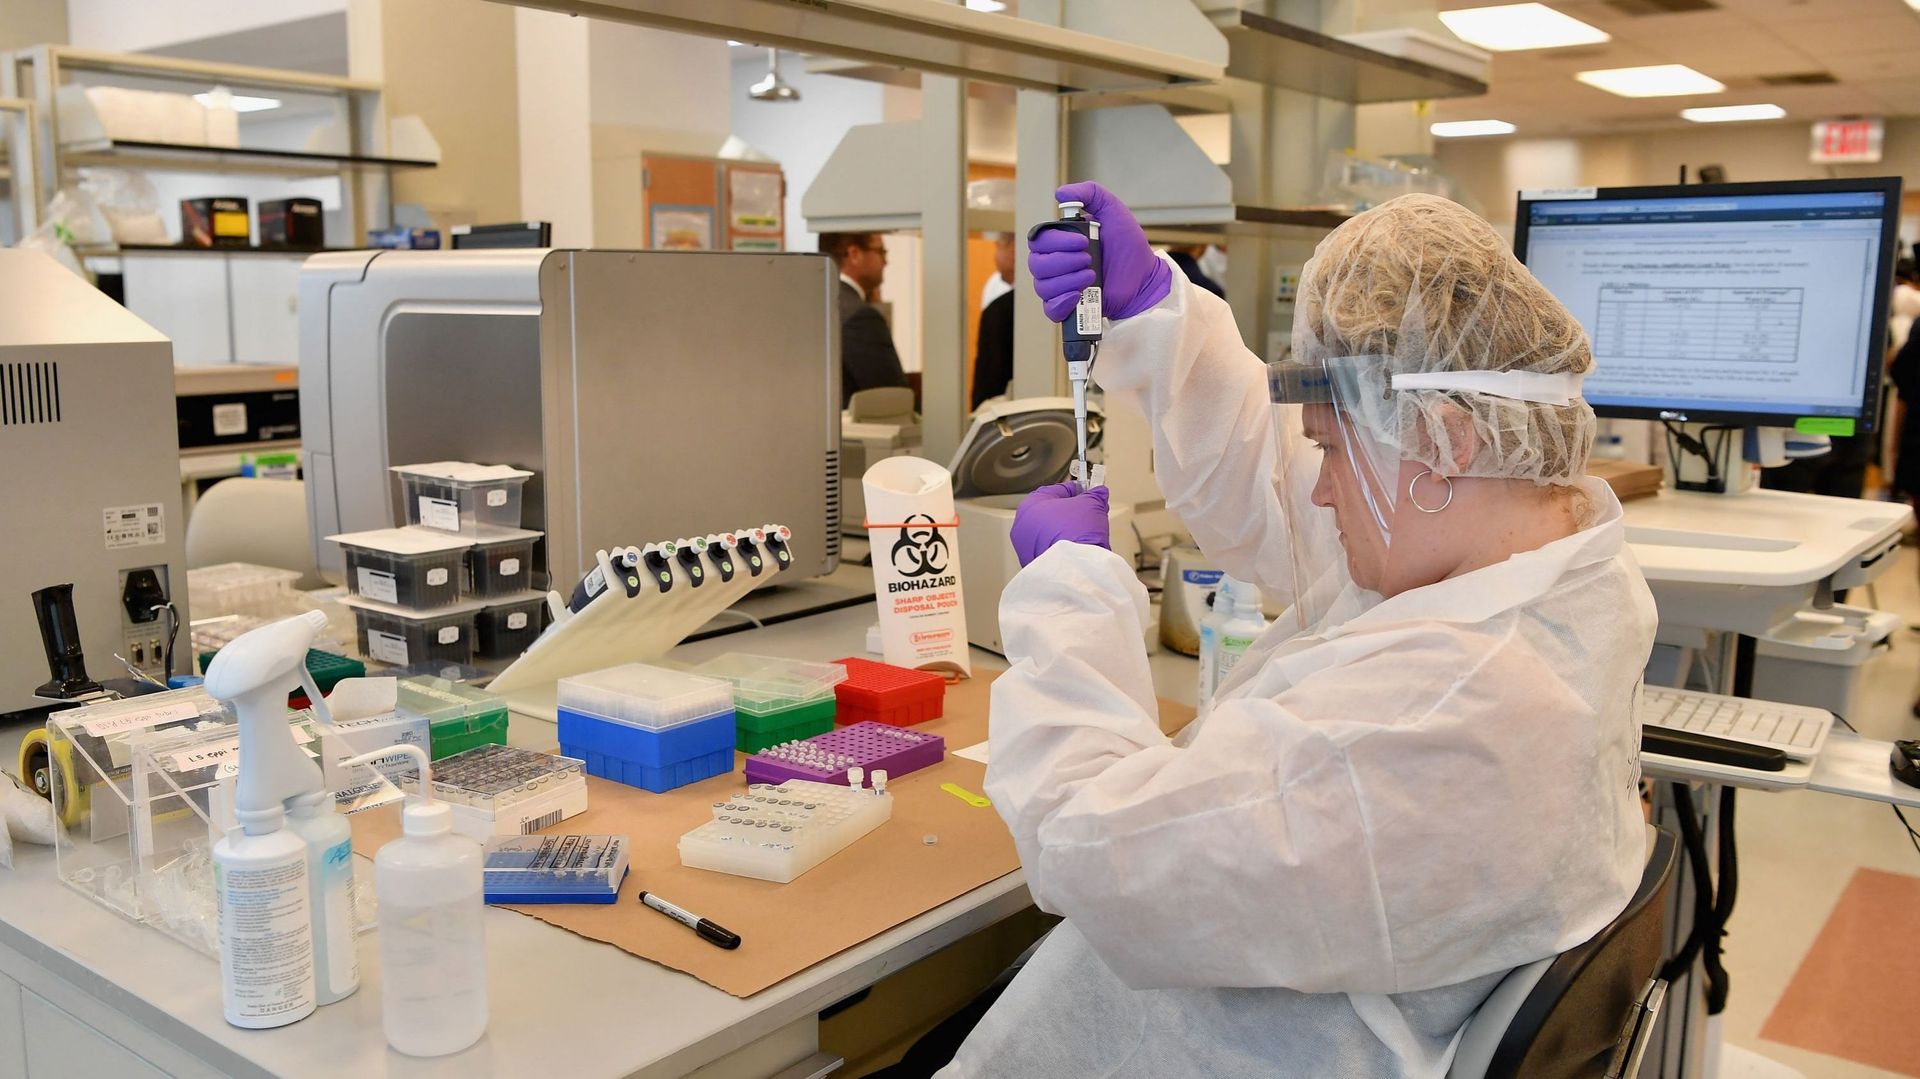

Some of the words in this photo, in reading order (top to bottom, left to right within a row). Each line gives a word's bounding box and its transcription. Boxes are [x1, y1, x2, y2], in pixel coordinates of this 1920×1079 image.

[1824, 121, 1871, 156] EXIT
[888, 576, 956, 593] BIOHAZARD
[893, 604, 935, 614] DISPOSAL
[937, 600, 958, 609] POUCH
[895, 596, 924, 605] SHARP
[926, 592, 956, 602] OBJECTS
[335, 782, 380, 799] NALGENE
